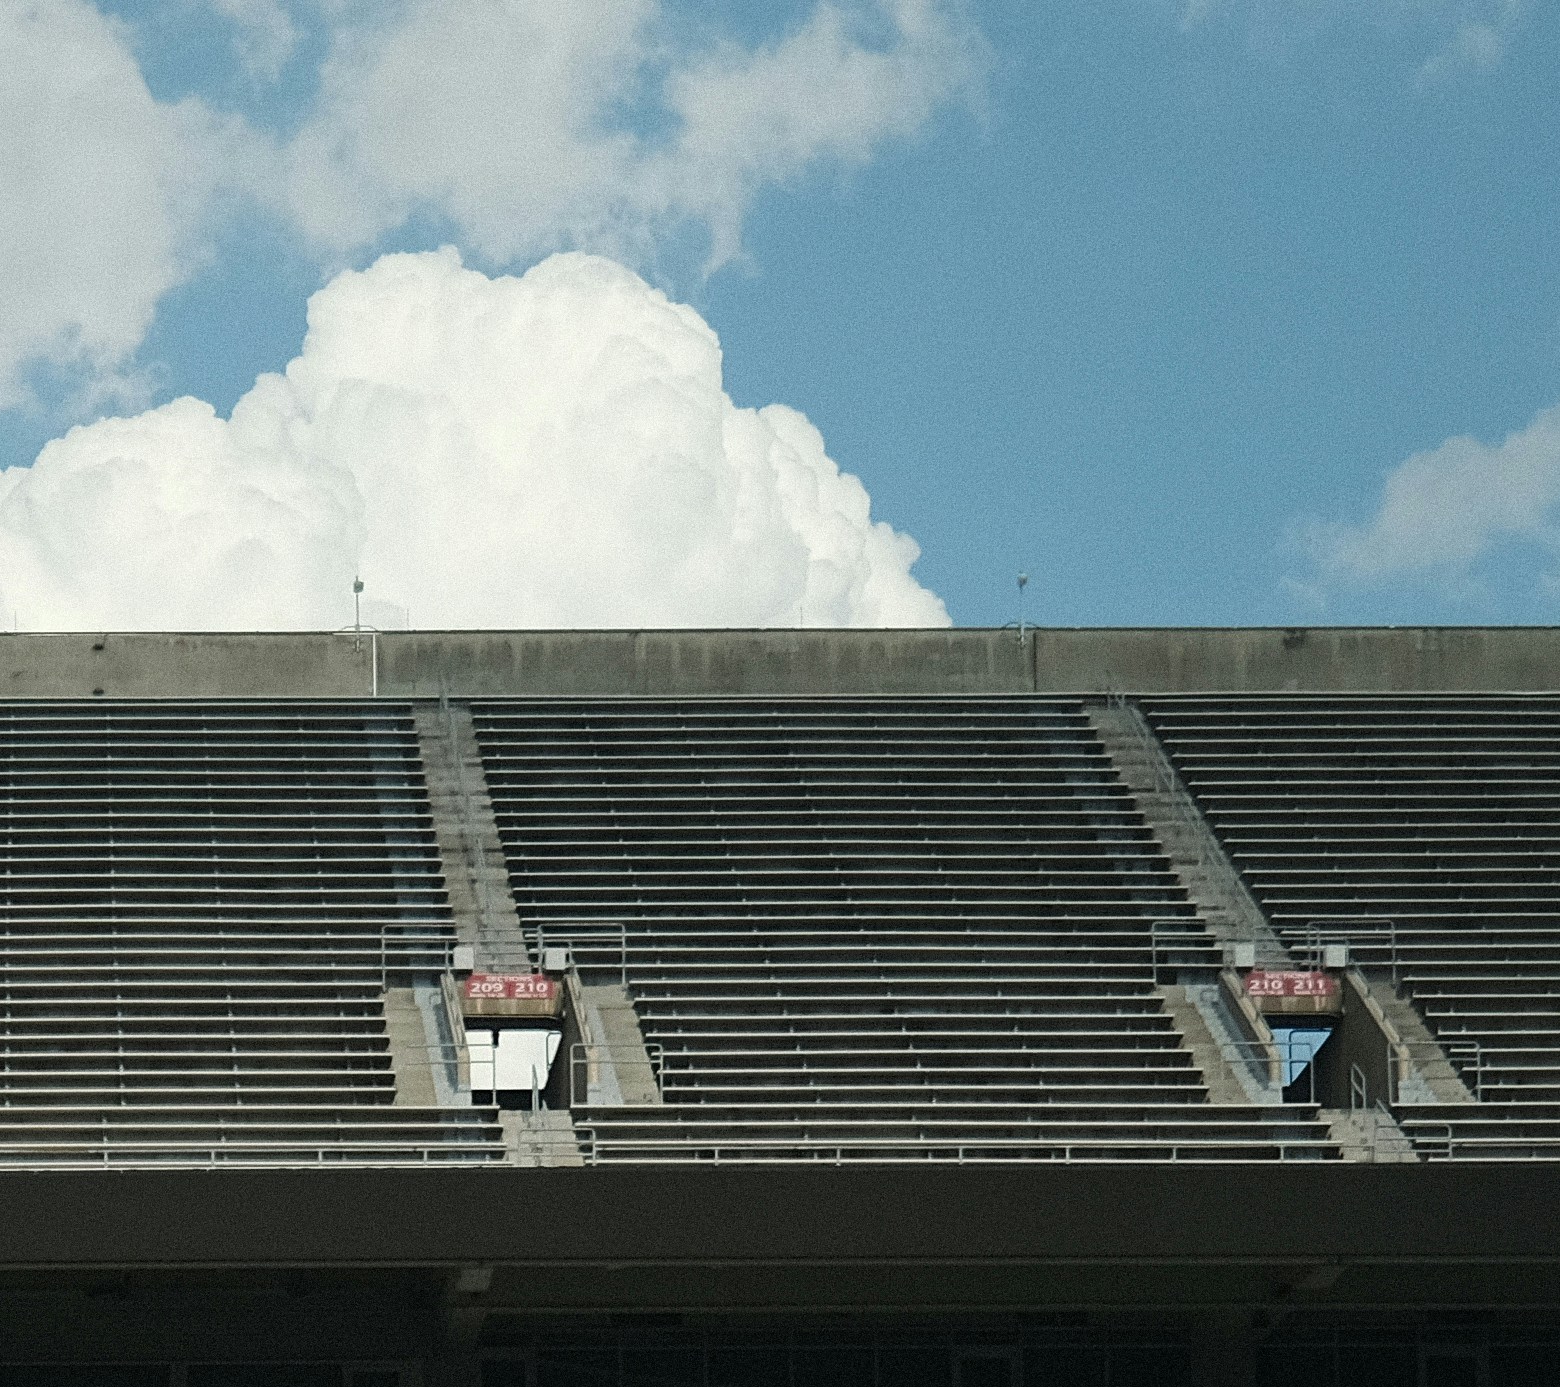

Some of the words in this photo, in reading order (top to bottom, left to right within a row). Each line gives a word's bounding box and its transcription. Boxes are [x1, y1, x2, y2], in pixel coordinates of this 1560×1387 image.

[471, 983, 503, 992] 209
[515, 983, 548, 992] 210
[1250, 980, 1283, 989] 210
[1294, 979, 1325, 989] 211
